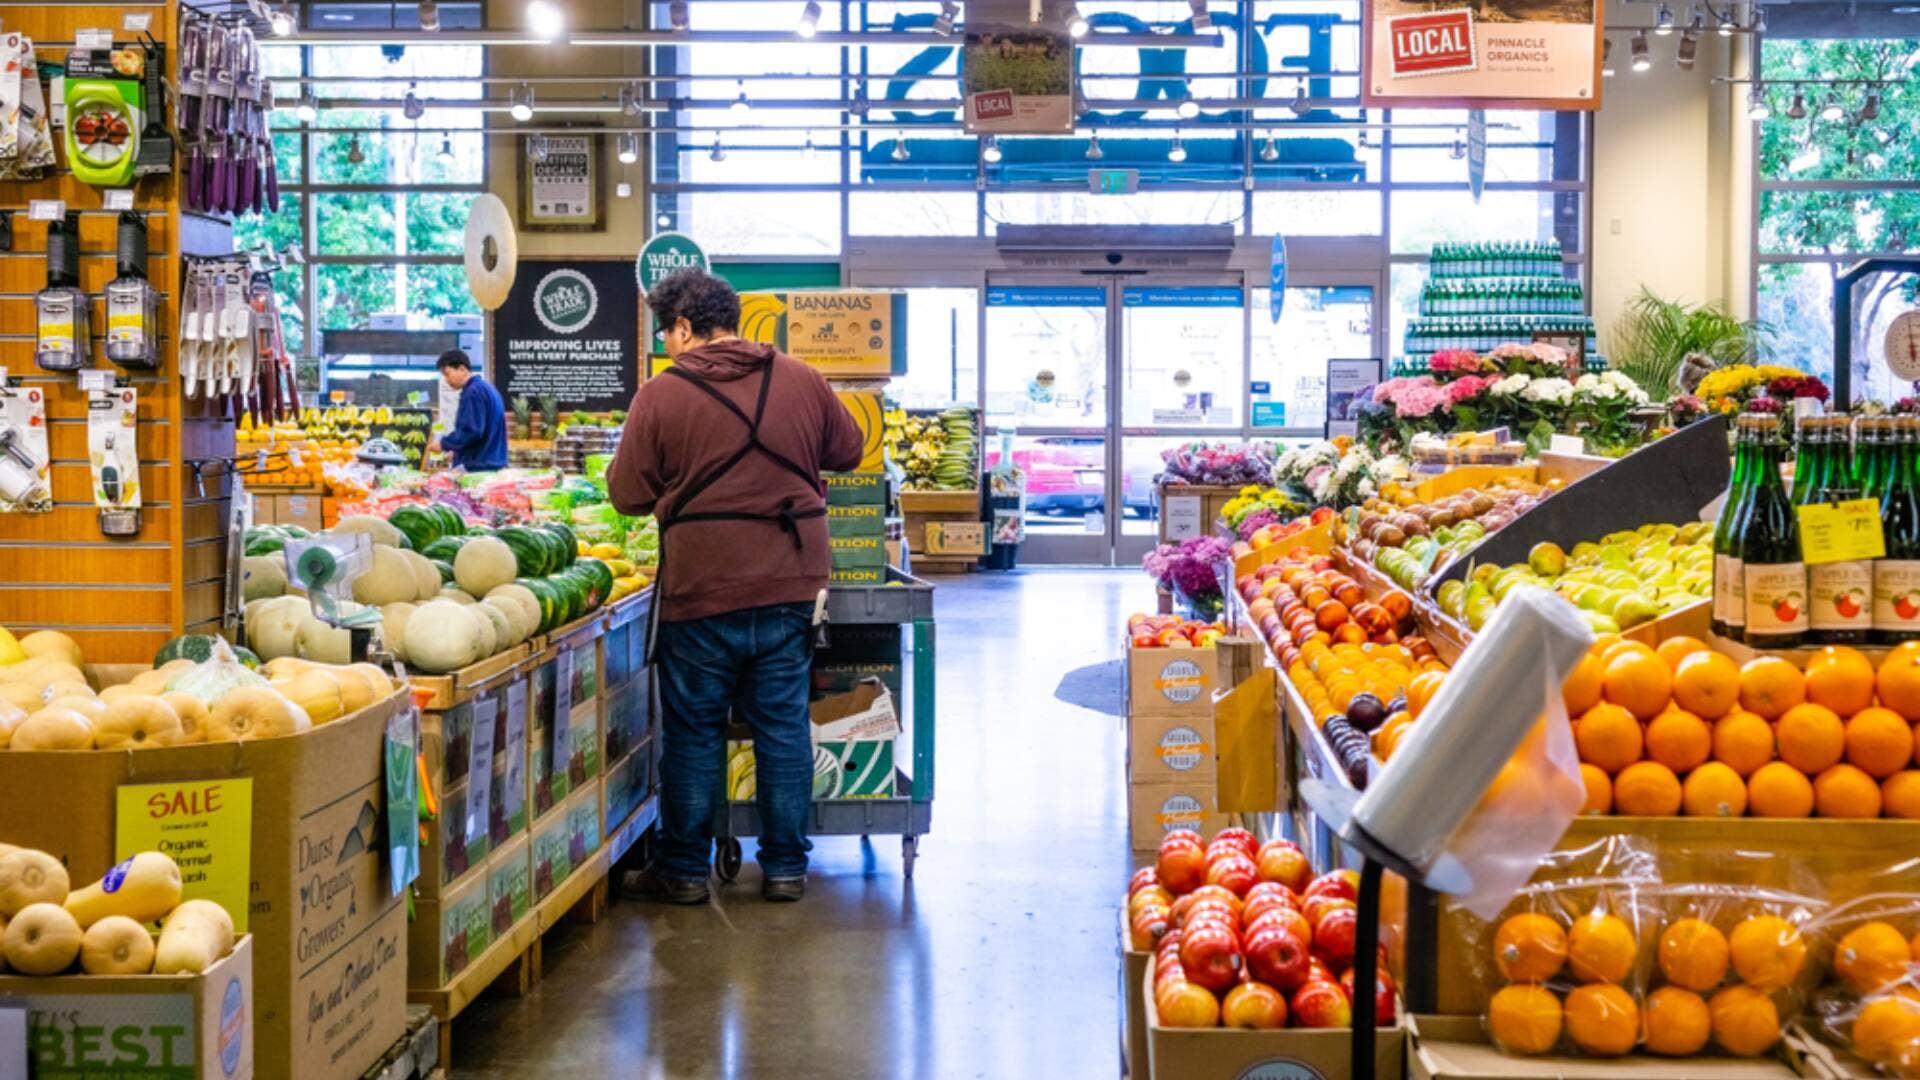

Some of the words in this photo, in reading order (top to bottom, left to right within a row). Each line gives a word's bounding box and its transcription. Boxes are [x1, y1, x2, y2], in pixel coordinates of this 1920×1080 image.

[1397, 27, 1467, 58] LOCAL
[1487, 38, 1546, 48] PINNACLE
[1487, 52, 1549, 61] ORGANICS
[977, 97, 1010, 113] LOCAL
[647, 253, 700, 268] WHOLE
[794, 296, 872, 311] BANANAS
[508, 340, 582, 350] IMPROVING
[585, 340, 620, 350] LIVES
[826, 476, 877, 487] DITION
[826, 506, 878, 517] DITION
[148, 785, 223, 818] SALE
[157, 838, 208, 854] Organic
[298, 834, 334, 873] Durst
[297, 914, 346, 964] Growers
[31, 1025, 185, 1069] BEST
